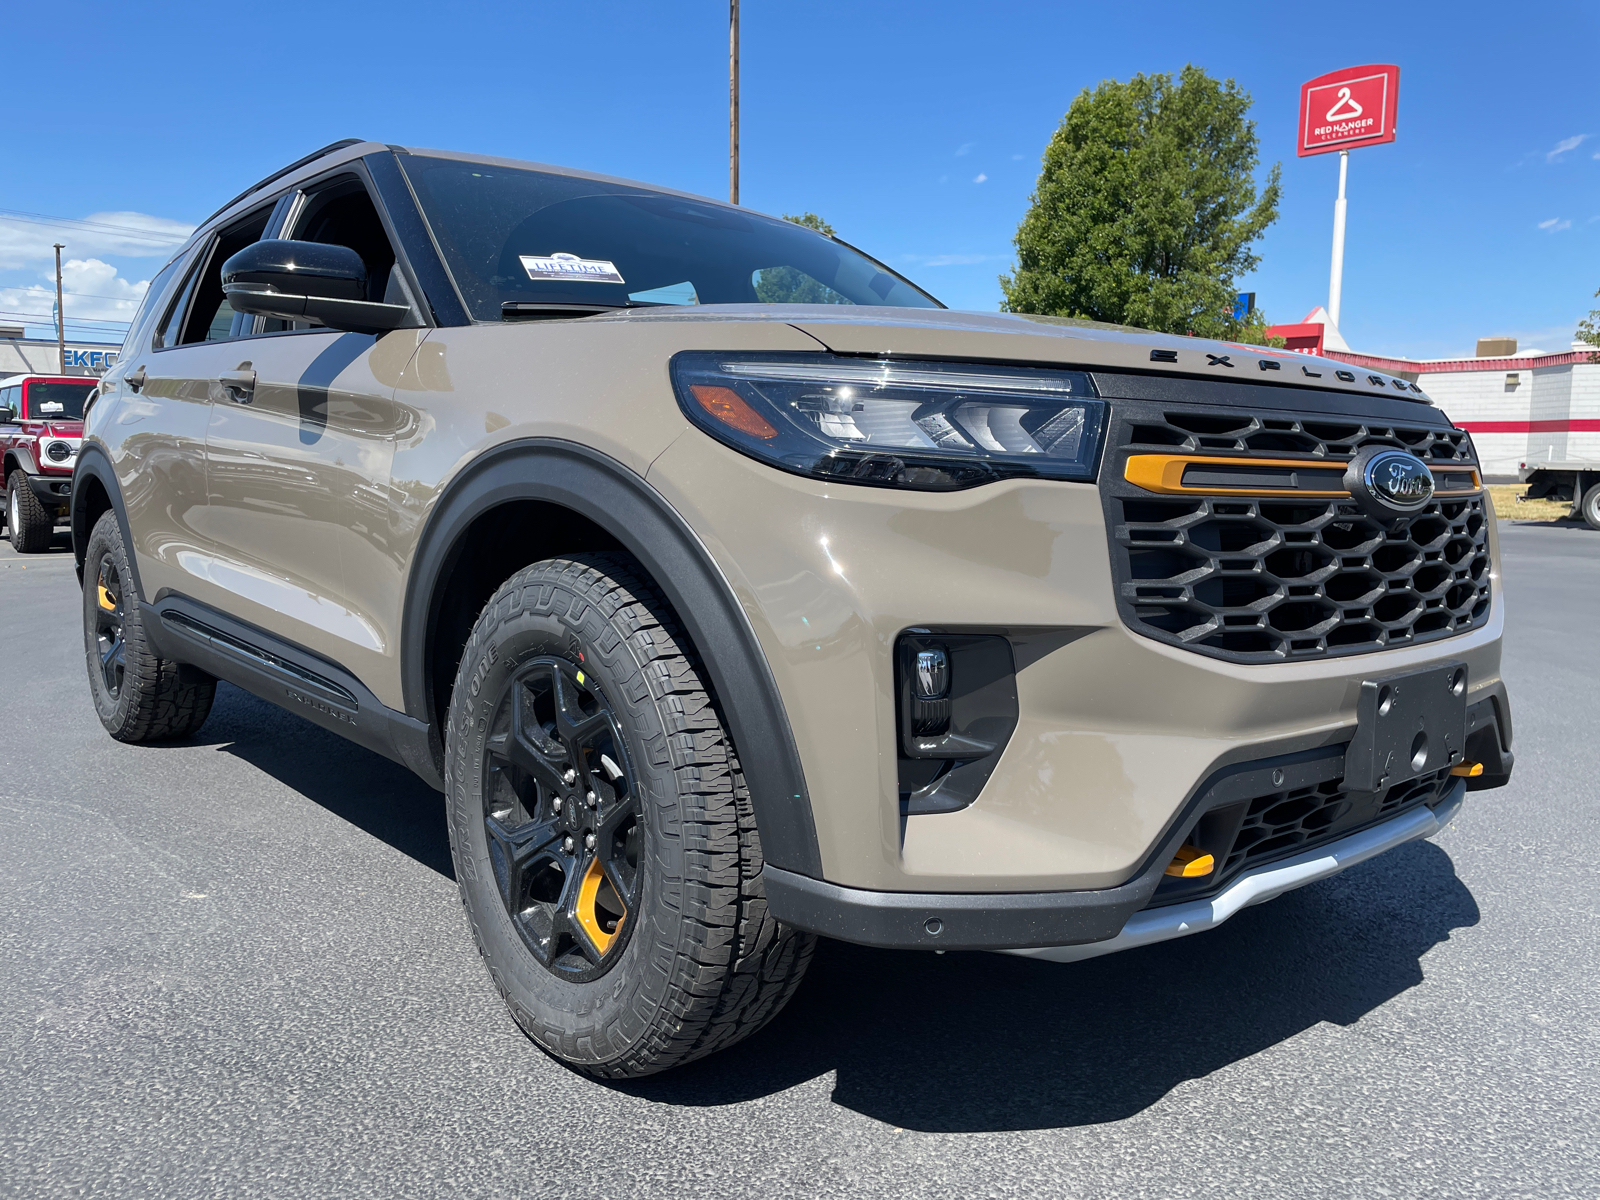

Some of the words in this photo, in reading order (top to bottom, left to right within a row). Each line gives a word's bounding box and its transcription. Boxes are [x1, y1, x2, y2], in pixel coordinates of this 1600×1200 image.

[1314, 126, 1332, 136] RED
[1333, 118, 1374, 132] HANGER
[1321, 128, 1366, 140] CLEANERS
[535, 262, 607, 274] LIFETIME
[1150, 349, 1423, 394] EXPLORER
[1389, 462, 1424, 495] Ford
[286, 689, 358, 727] EXPLORER
